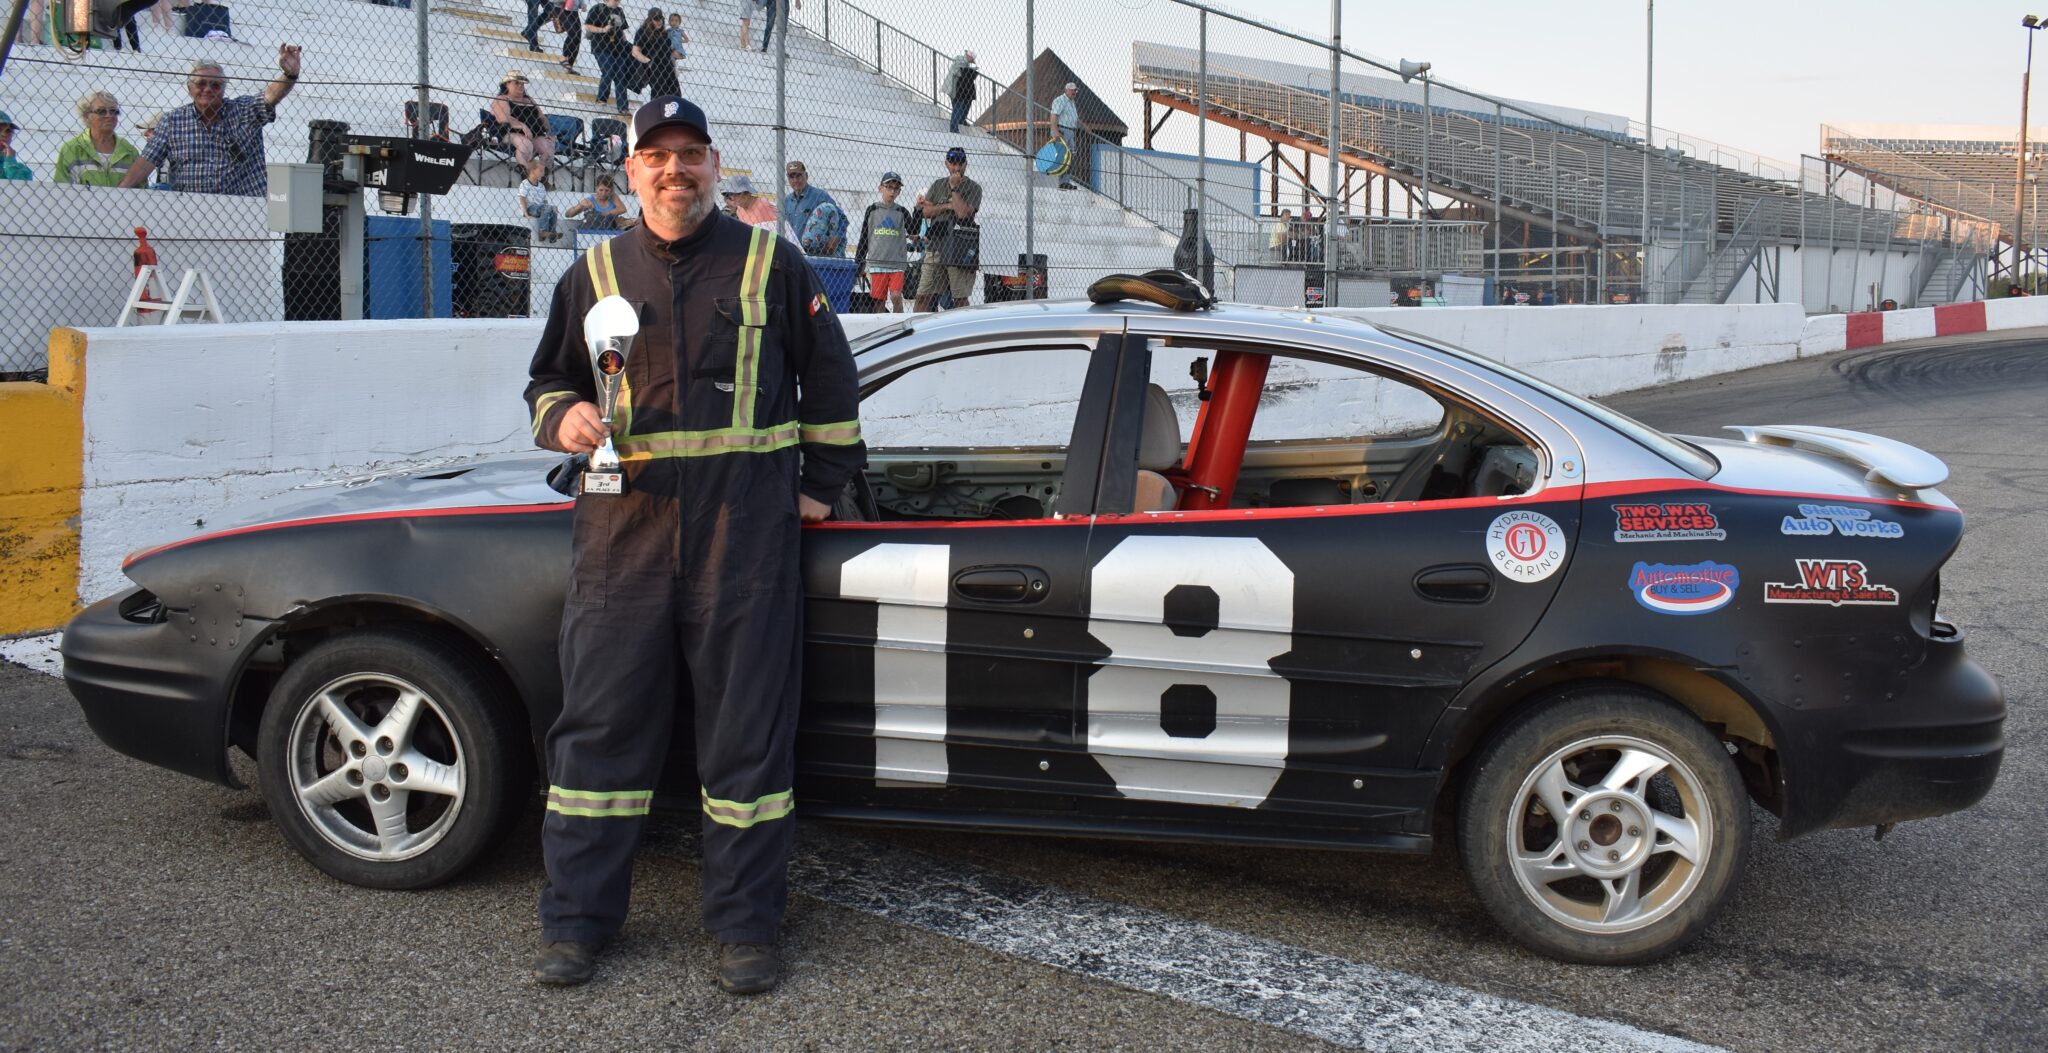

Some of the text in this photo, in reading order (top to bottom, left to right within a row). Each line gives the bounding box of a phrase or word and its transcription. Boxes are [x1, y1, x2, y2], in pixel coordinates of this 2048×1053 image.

[414, 152, 455, 167] WHELEN
[366, 168, 388, 186] LEN
[873, 228, 899, 236] adidas
[1615, 504, 1708, 517] TWO WAY
[1491, 512, 1558, 540] HYDRAULIC
[1619, 515, 1716, 532] SERVICES
[1783, 517, 1901, 534] Auto Works
[1705, 530, 1723, 538] Shop
[1495, 550, 1559, 576] BEARING
[1634, 567, 1734, 586] Automotive
[1800, 561, 1864, 590] WTS
[1650, 584, 1700, 594] BUY & SELL
[1769, 587, 1841, 602] Manufacturing
[1842, 591, 1850, 599] &
[1853, 588, 1876, 600] Sales
[840, 535, 1294, 808] 18
